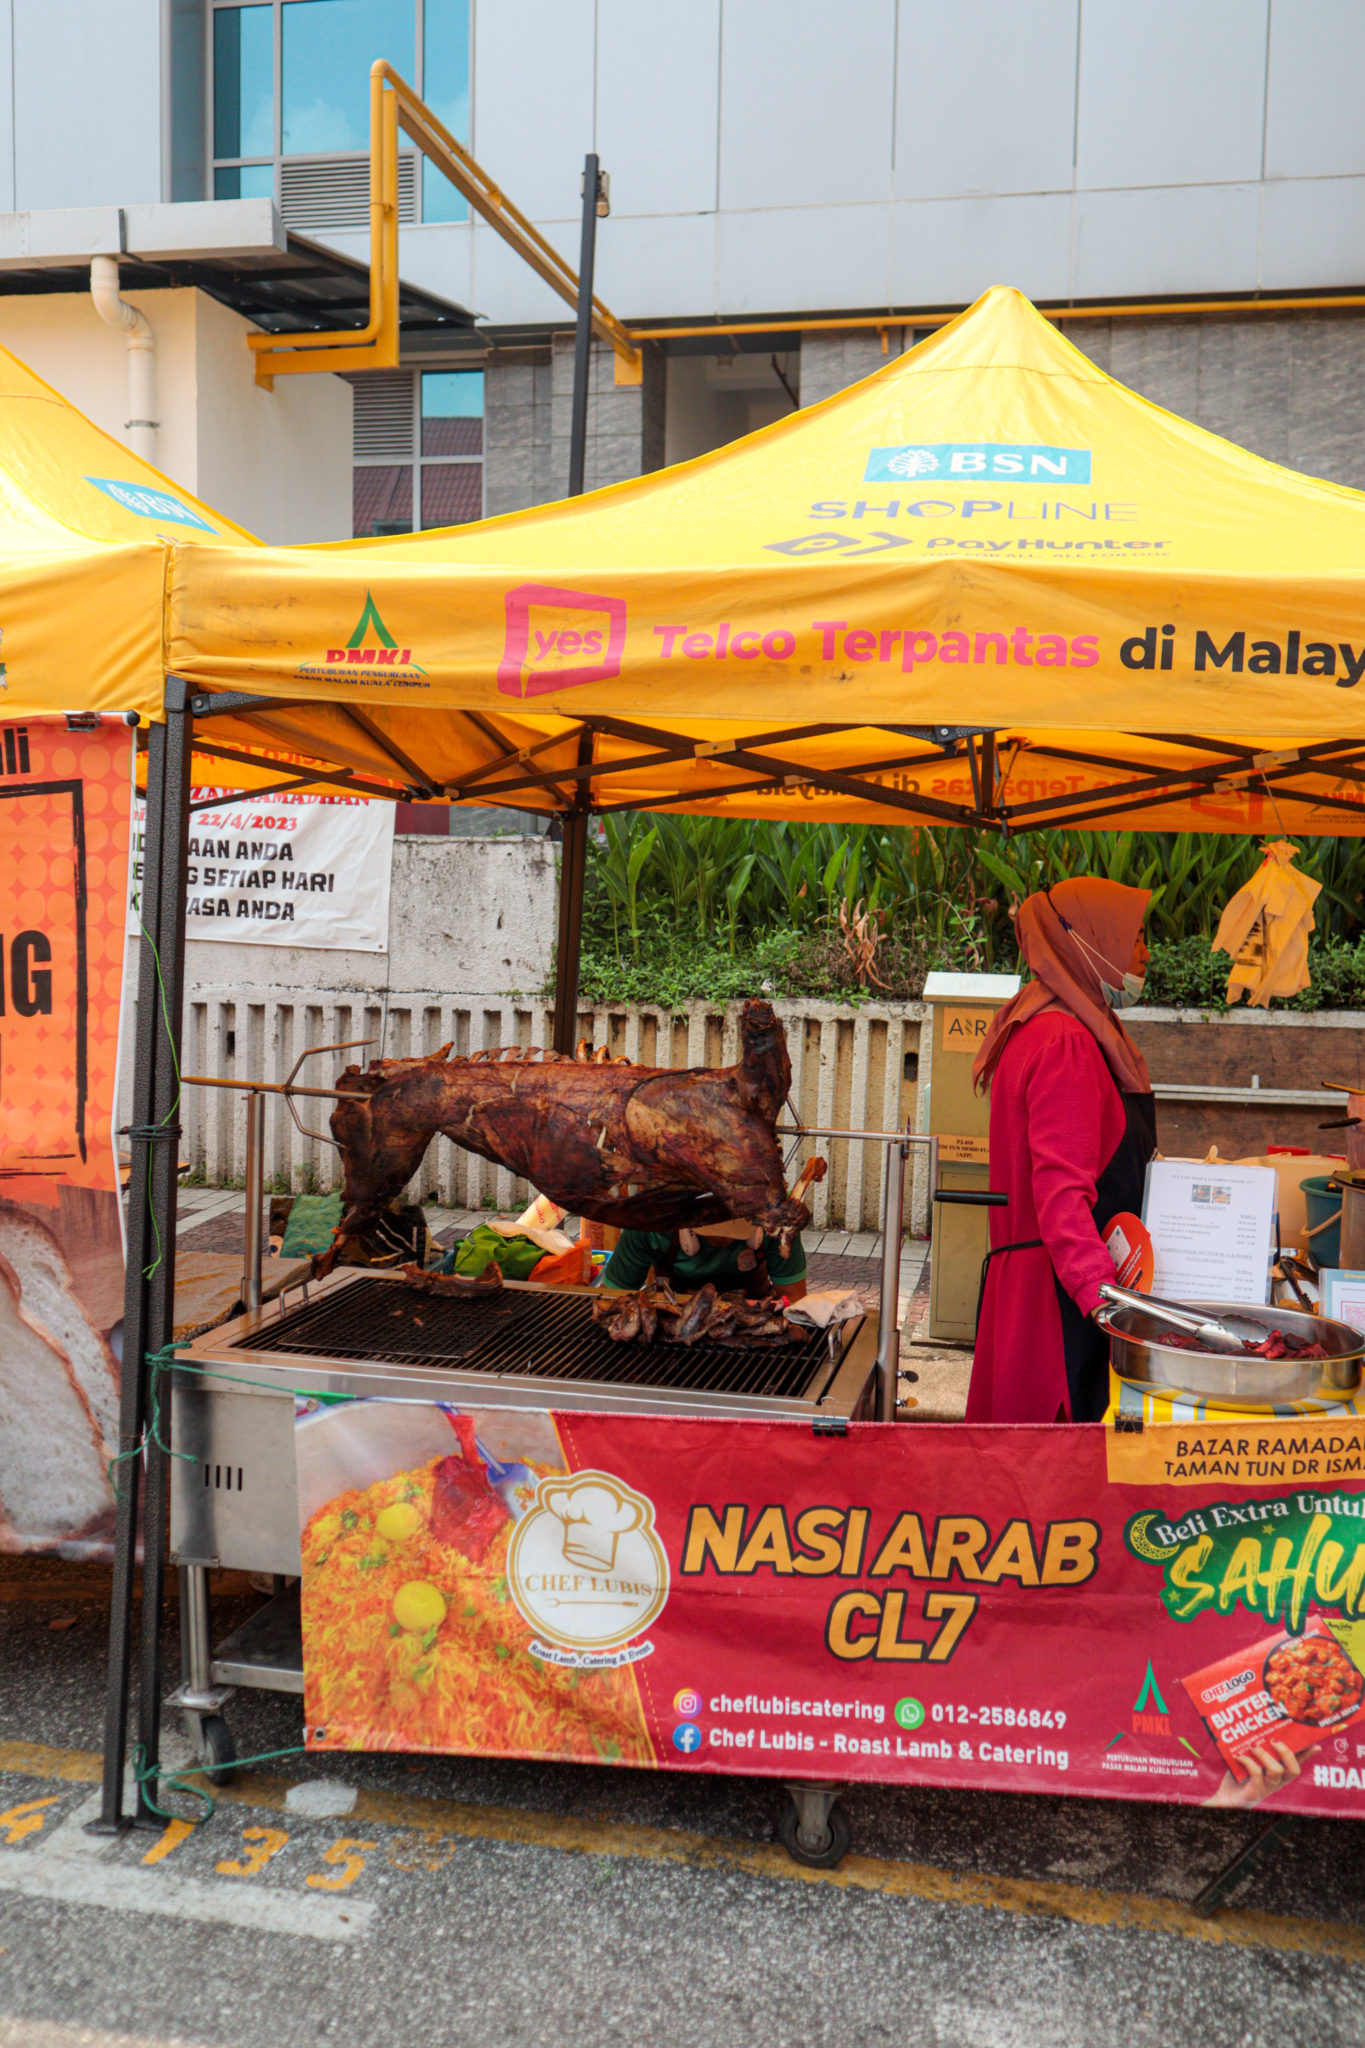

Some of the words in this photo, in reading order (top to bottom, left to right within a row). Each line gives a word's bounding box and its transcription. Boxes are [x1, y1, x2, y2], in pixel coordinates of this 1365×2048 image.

[950, 452, 1068, 476] BSN
[807, 499, 1139, 522] SHOPLINE
[534, 629, 604, 662] yes
[652, 622, 797, 661] Telco
[811, 620, 1100, 673] Terpantas
[1119, 624, 1177, 671] di
[1194, 630, 1365, 689] Malay
[198, 812, 298, 831] 22/4/2023
[235, 841, 294, 861] ANDA
[203, 867, 276, 889] SETIAP
[281, 870, 335, 892] HARI
[236, 899, 295, 921] ANDA
[0, 928, 53, 1018] G
[1176, 1438, 1250, 1458] BAZAR
[1256, 1435, 1365, 1457] RAMADA
[1164, 1461, 1240, 1478] TAMAN
[1246, 1460, 1286, 1477] TUN
[1291, 1460, 1320, 1476] DR
[1325, 1456, 1365, 1474] ISM
[1155, 1513, 1210, 1547] Beli
[1210, 1501, 1291, 1529] Extra
[1296, 1494, 1365, 1519] Untu
[681, 1503, 870, 1577] NASI
[867, 1511, 1102, 1589] ARAB
[524, 1573, 585, 1593] CHEF
[591, 1576, 653, 1597] LUBIS
[1169, 1513, 1365, 1631] SAHU
[825, 1590, 979, 1664] CL7
[582, 1655, 617, 1666] Catering
[709, 1694, 886, 1724] cheflubiscatering
[931, 1703, 1067, 1730] 012-2586849
[1211, 1690, 1275, 1730] BUTTER
[1220, 1701, 1289, 1744] CHICKEN
[1132, 1714, 1172, 1737] PMKL
[709, 1728, 755, 1748] Chef
[759, 1729, 815, 1751] Lubis
[833, 1733, 891, 1756] Roast
[896, 1736, 953, 1759] Lamb
[958, 1740, 974, 1761] &
[978, 1742, 1069, 1771] Catering
[1313, 1764, 1365, 1790] #DA
